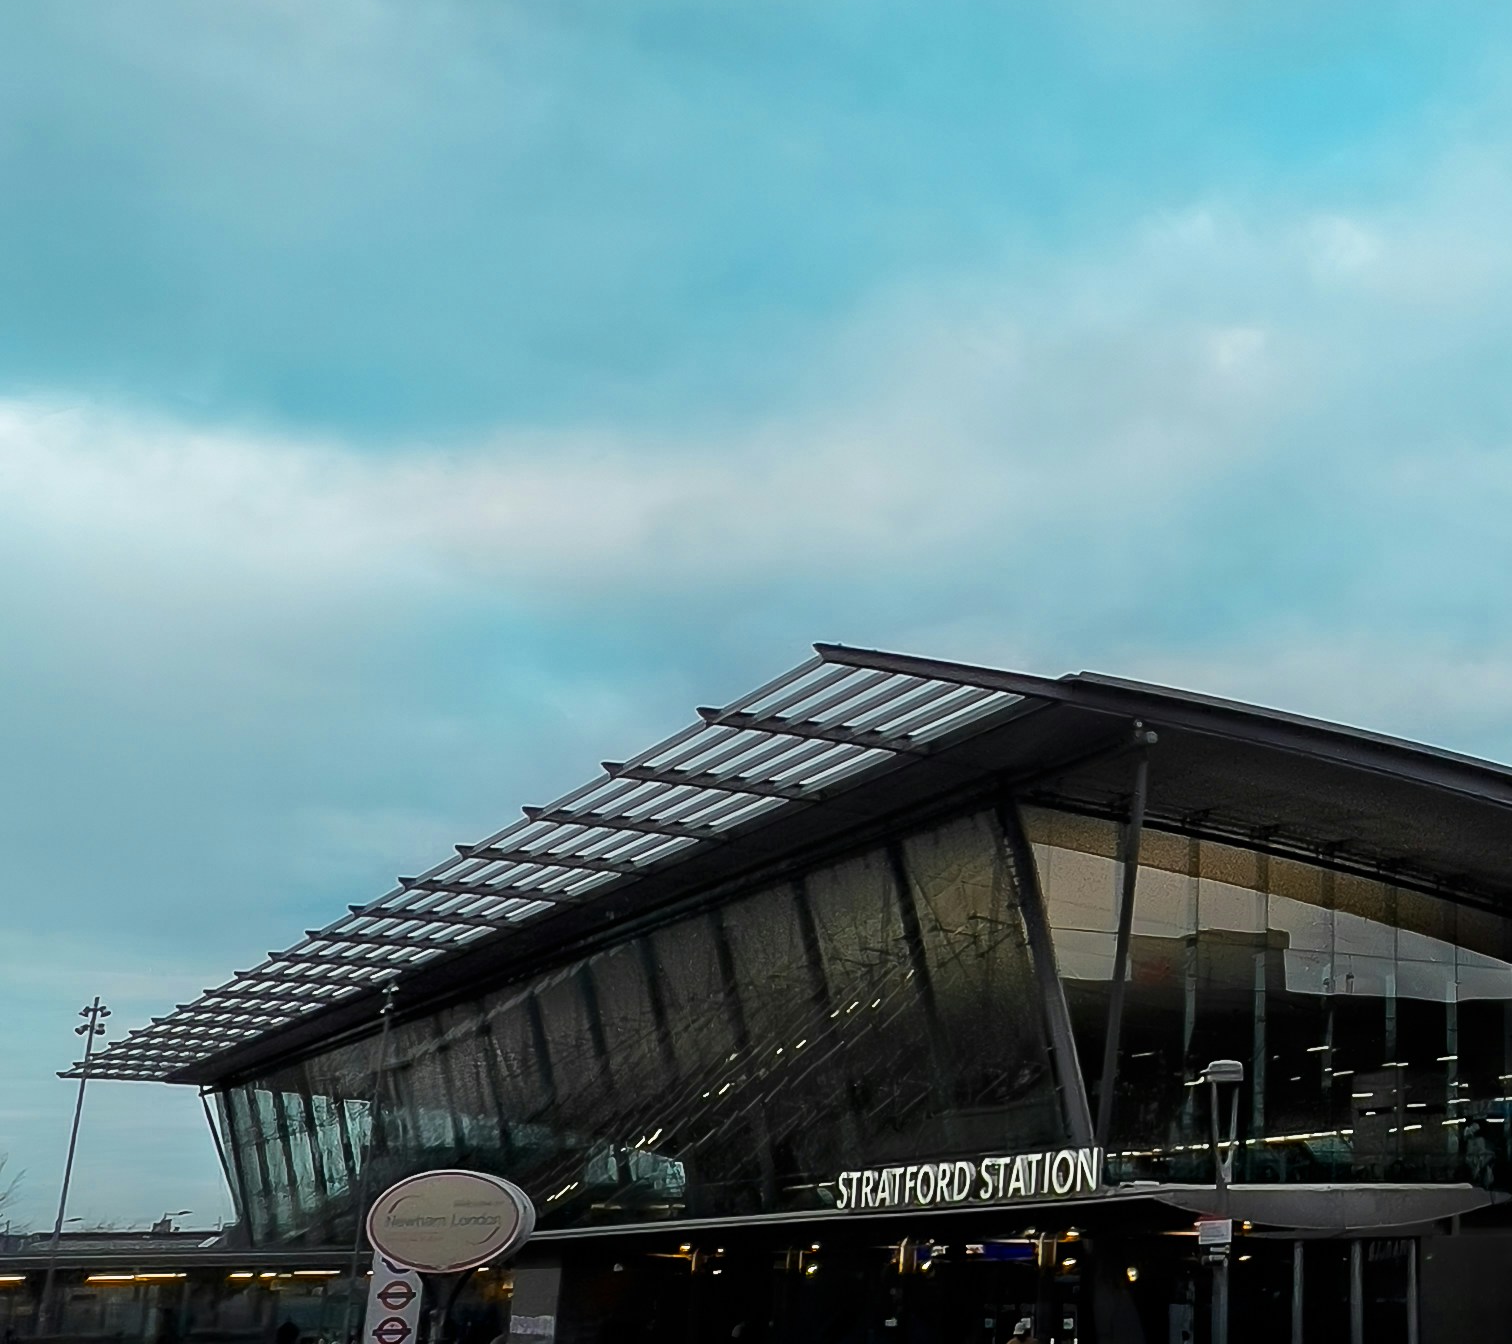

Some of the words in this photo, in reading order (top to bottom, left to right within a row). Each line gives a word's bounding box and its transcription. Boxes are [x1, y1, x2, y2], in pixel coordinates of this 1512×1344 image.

[836, 1160, 972, 1209] STRATFORD
[979, 1146, 1101, 1201] STATION
[450, 1211, 501, 1228] London
